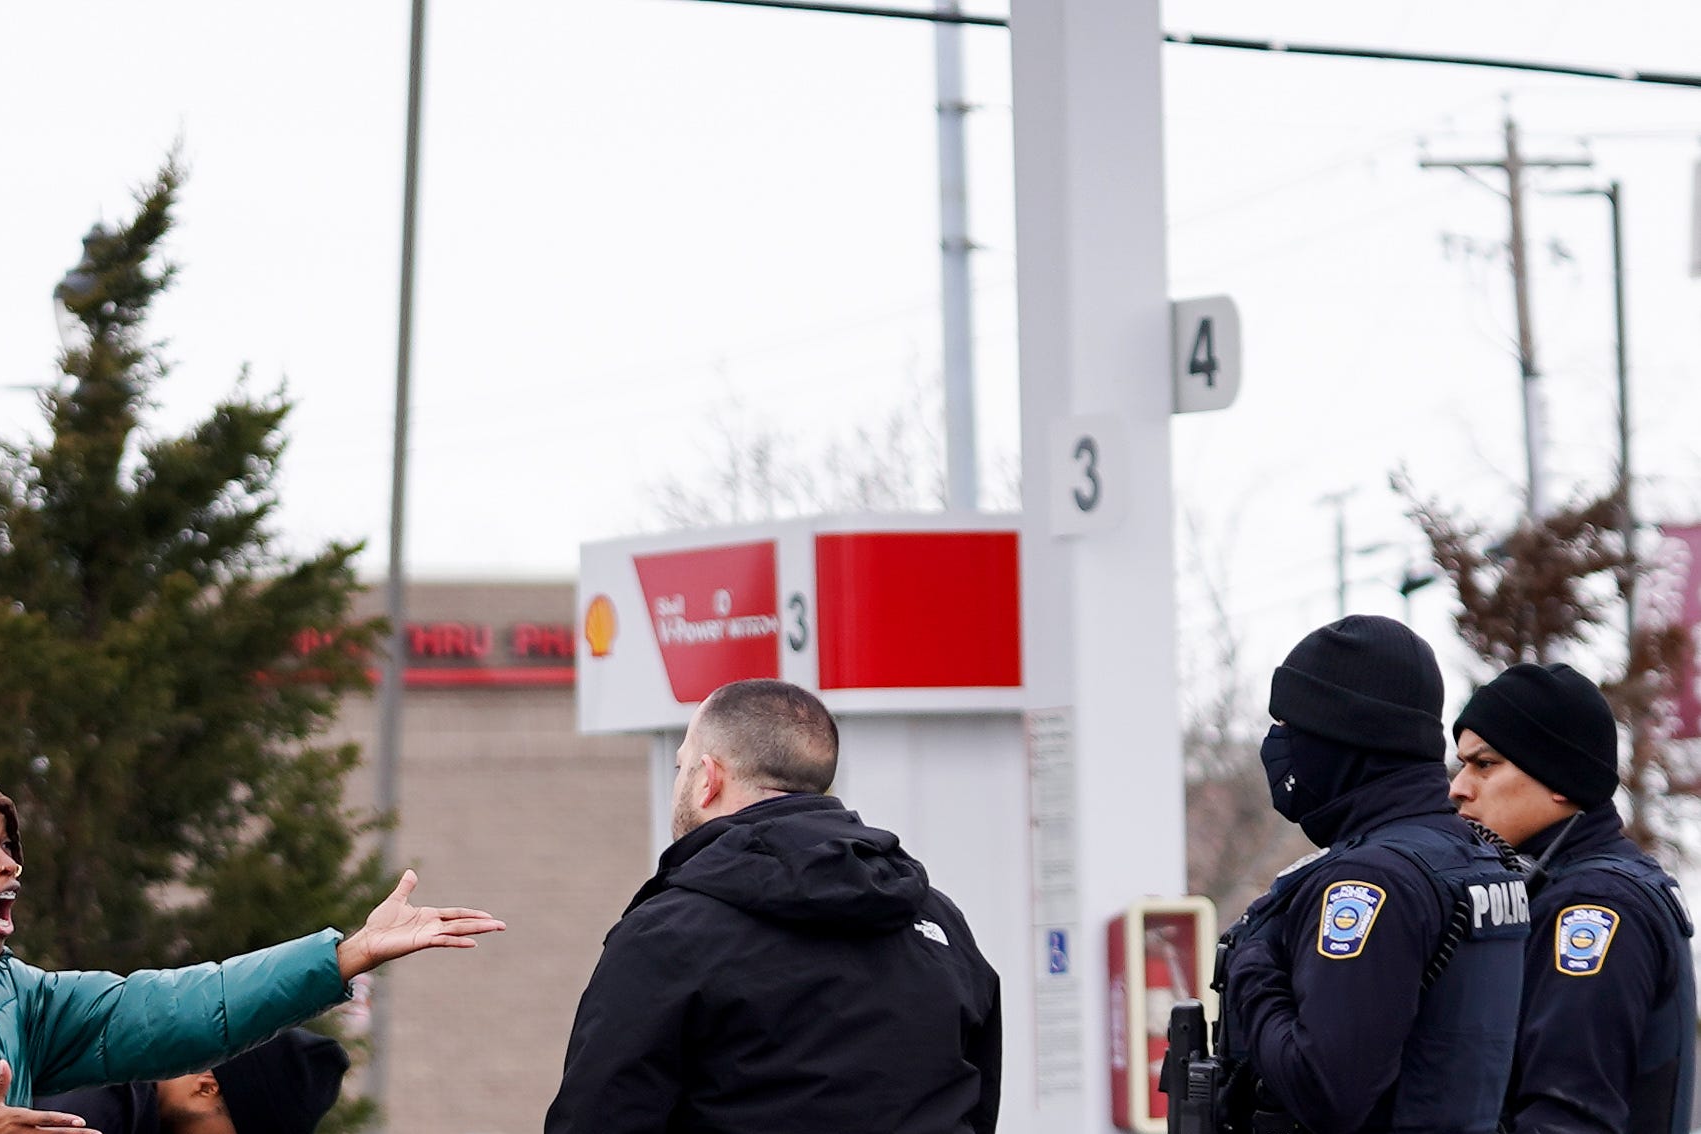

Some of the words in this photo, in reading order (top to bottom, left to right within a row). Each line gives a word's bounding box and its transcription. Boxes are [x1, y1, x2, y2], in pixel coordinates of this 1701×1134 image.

[1189, 316, 1219, 388] 4
[1071, 435, 1102, 512] 3
[786, 590, 808, 652] 3
